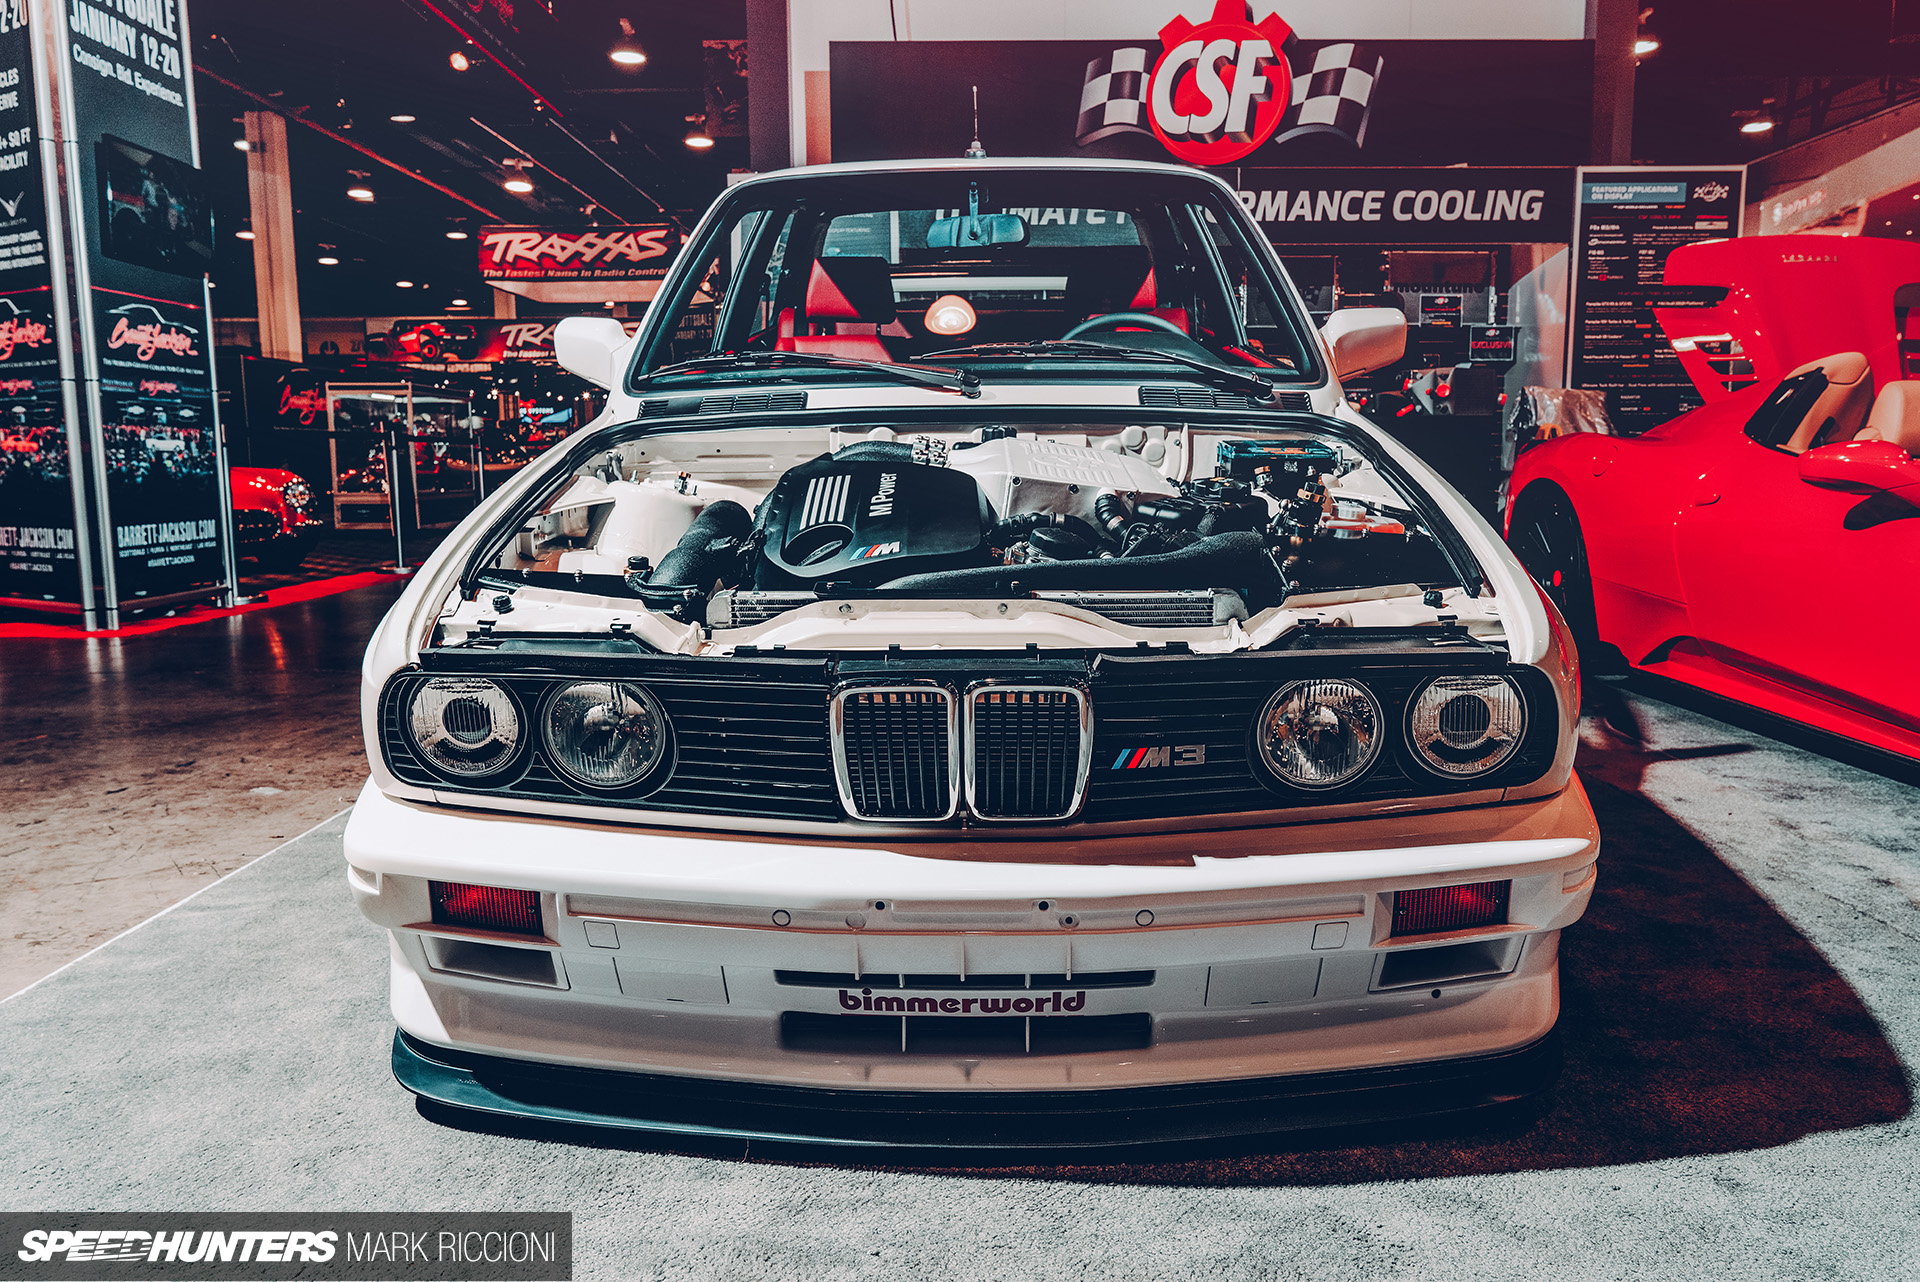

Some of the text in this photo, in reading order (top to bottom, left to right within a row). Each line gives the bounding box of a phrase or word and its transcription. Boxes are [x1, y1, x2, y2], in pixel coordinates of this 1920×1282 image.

[70, 0, 136, 59] JANUARY
[1151, 39, 1275, 133] CSF
[1392, 189, 1545, 222] COOLING
[483, 230, 669, 264] TRAXXAS
[504, 269, 546, 278] Fastest
[547, 269, 579, 278] Name
[594, 268, 626, 278] Radio
[838, 987, 1086, 1014] bimmerworld
